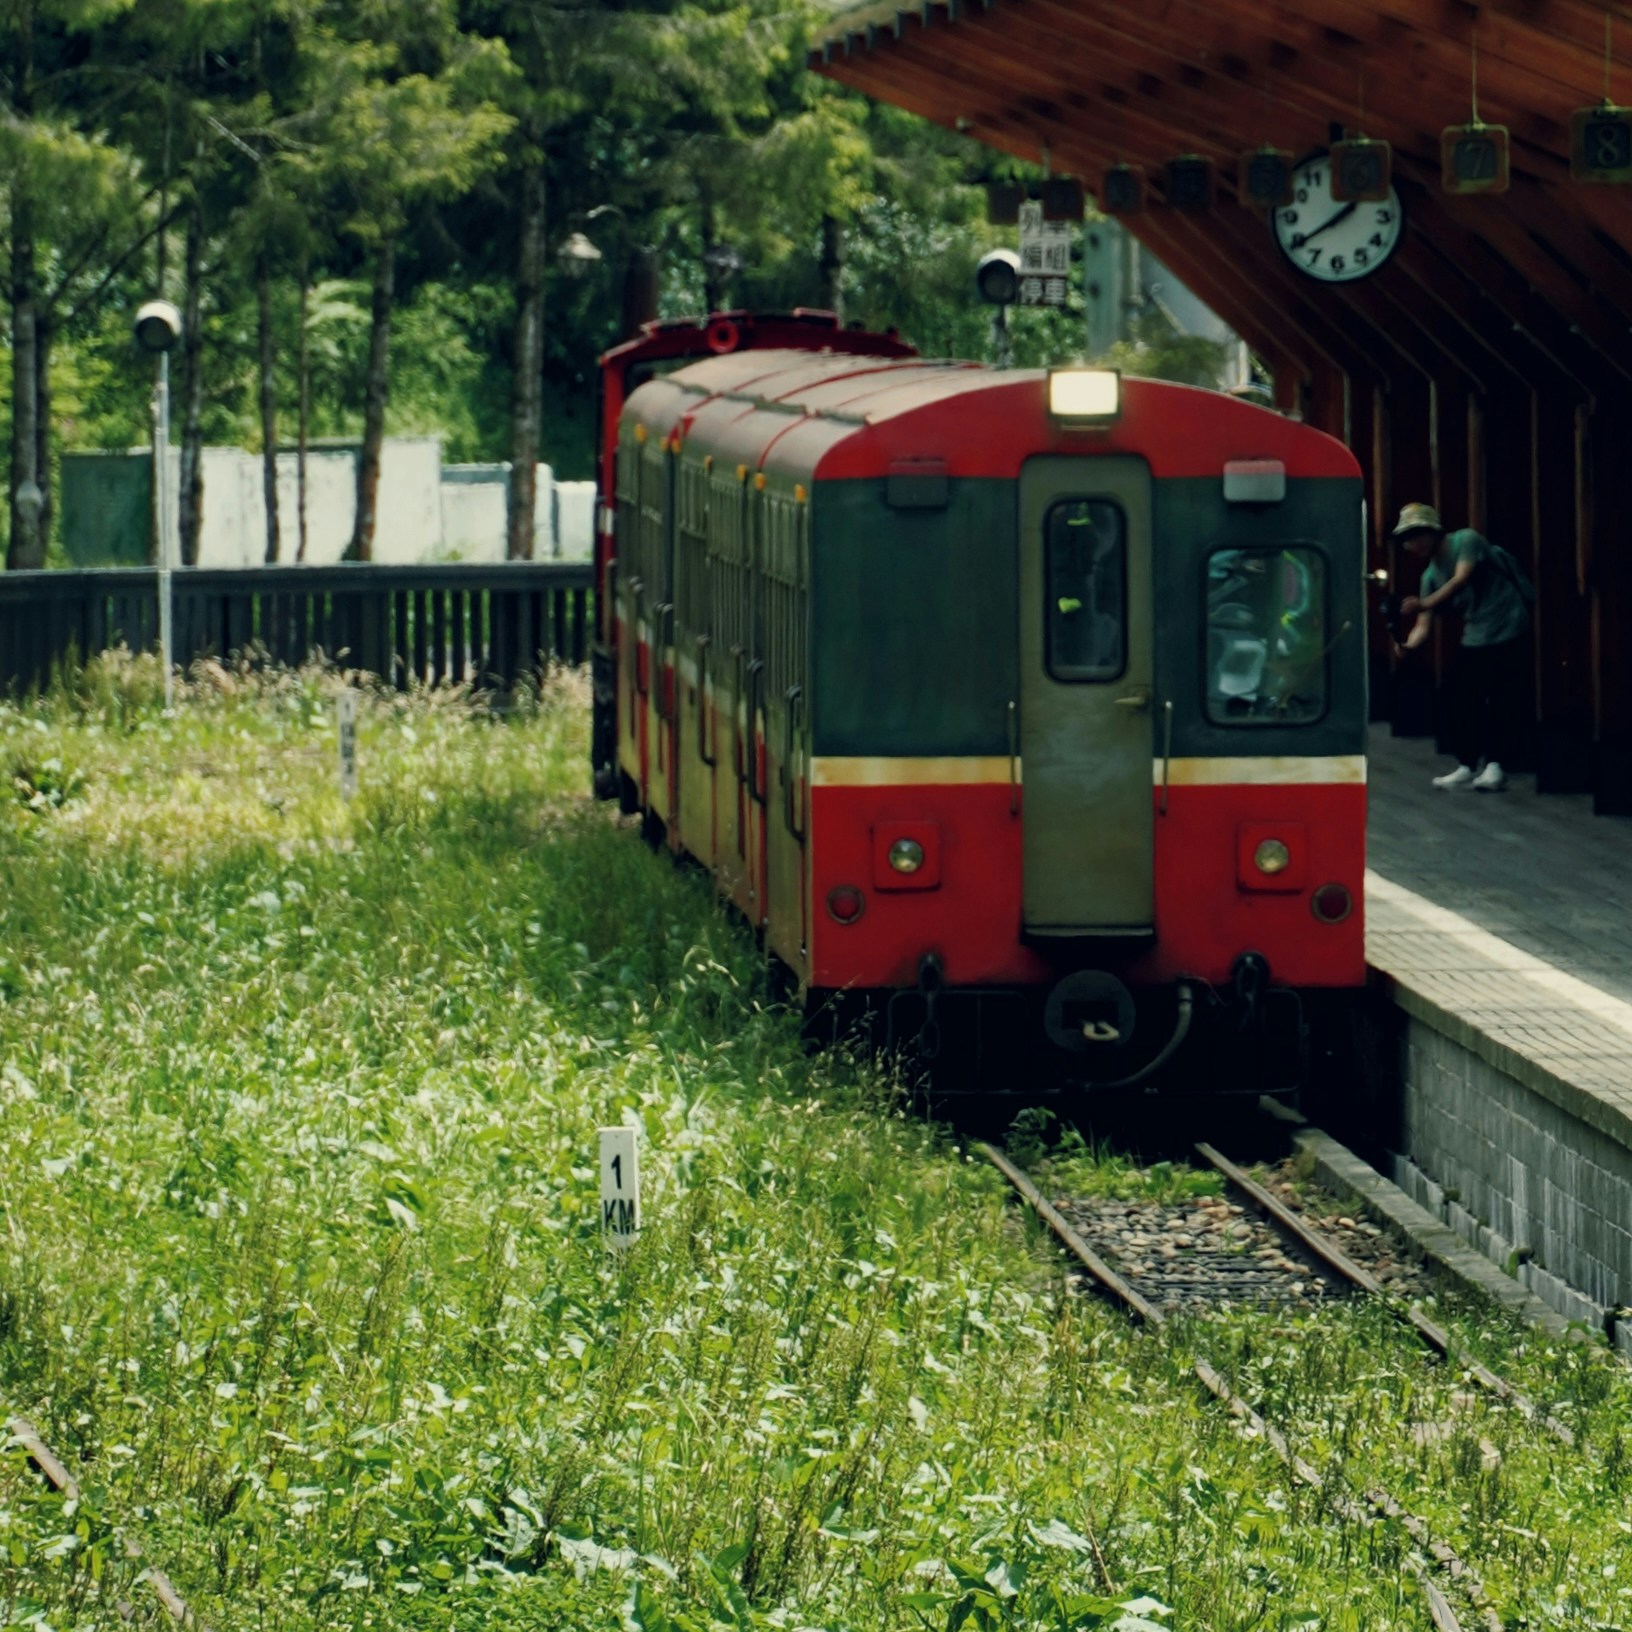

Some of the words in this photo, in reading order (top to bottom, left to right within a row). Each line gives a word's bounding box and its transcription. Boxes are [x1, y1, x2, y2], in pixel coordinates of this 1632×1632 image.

[1595, 125, 1619, 167] 8
[1465, 142, 1488, 178] 7
[1376, 209, 1391, 225] 3
[1369, 232, 1382, 248] 4
[1308, 248, 1322, 265] 7
[1330, 254, 1345, 270] 6
[1353, 248, 1368, 264] 5
[1021, 277, 1066, 305] 停車
[611, 1154, 622, 1189] 1
[604, 1198, 635, 1235] KM
